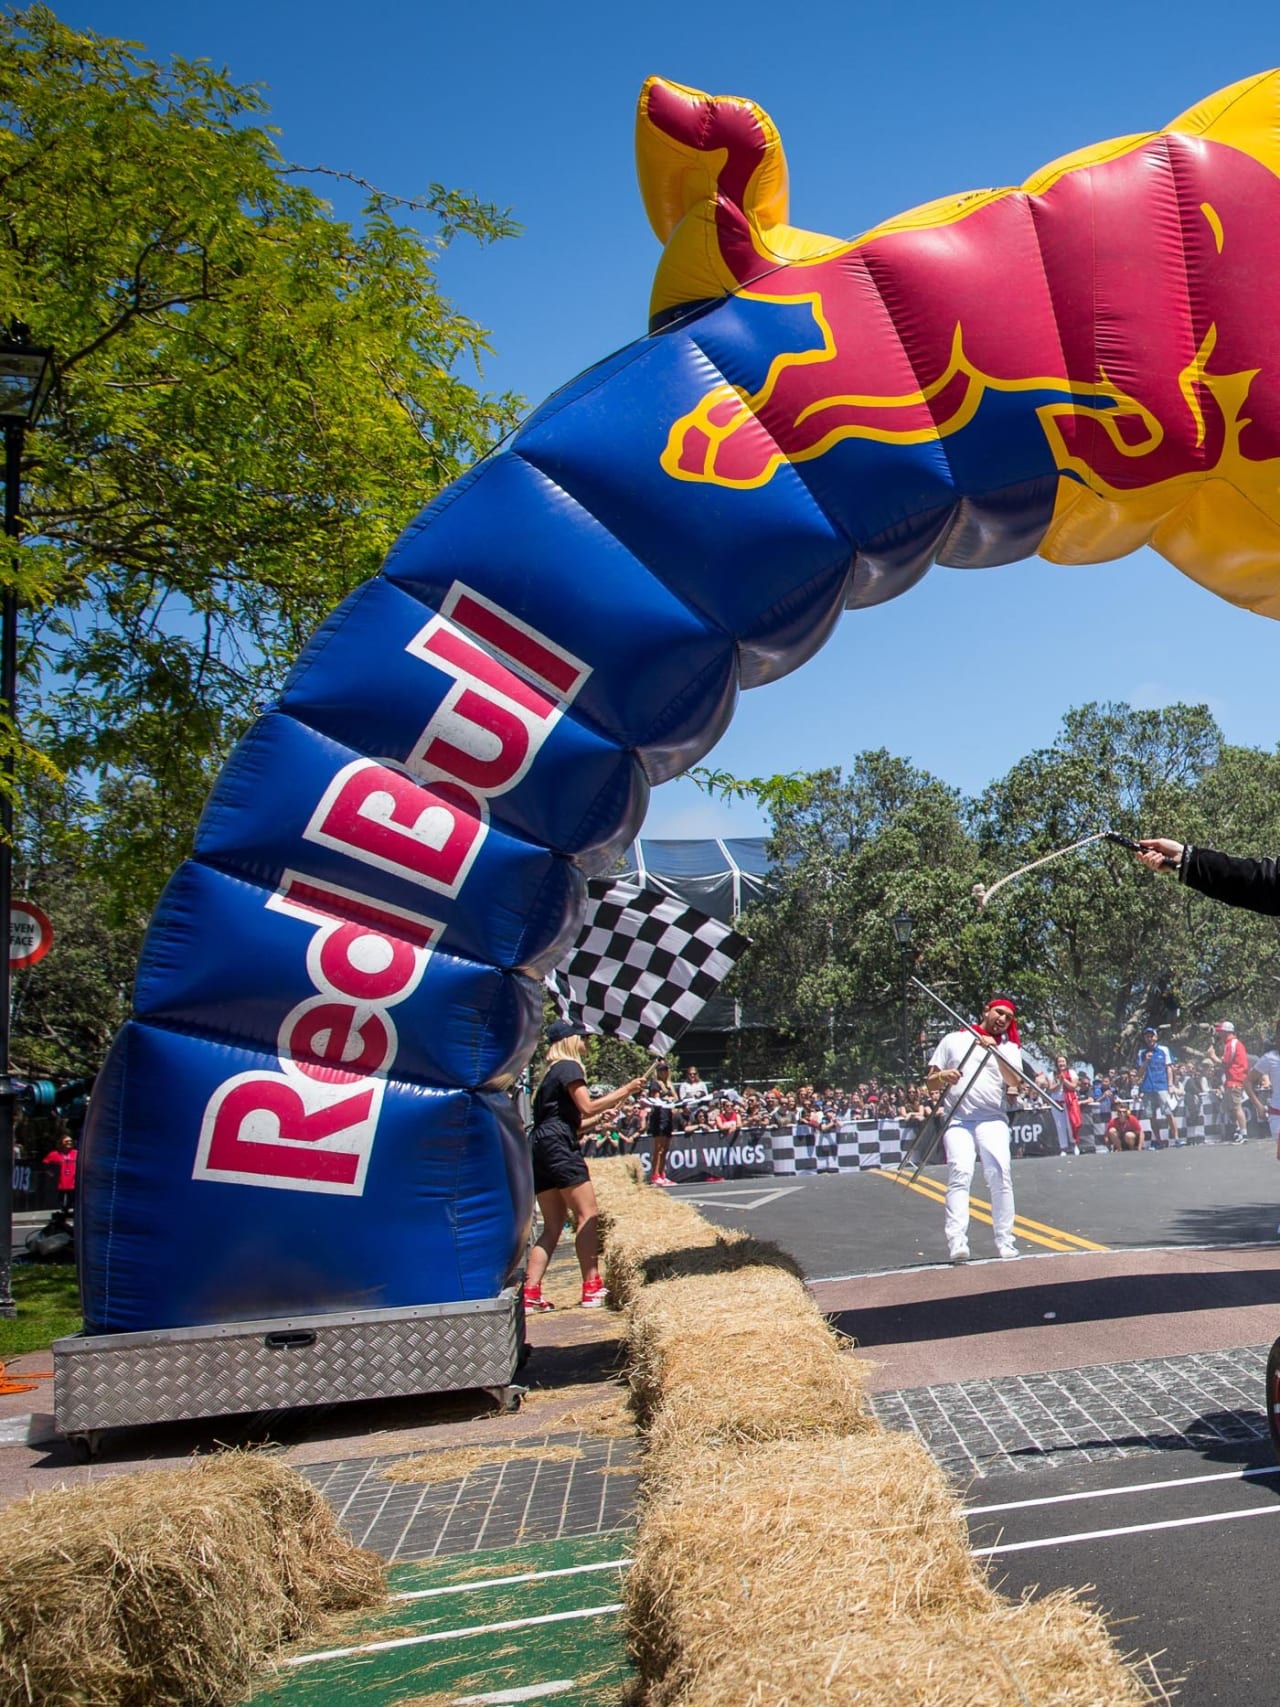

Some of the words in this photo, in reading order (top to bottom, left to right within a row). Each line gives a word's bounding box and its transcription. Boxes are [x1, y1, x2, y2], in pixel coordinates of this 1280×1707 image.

[303, 580, 593, 898] Bull
[192, 869, 447, 1196] Red
[703, 1145, 765, 1167] WINGS
